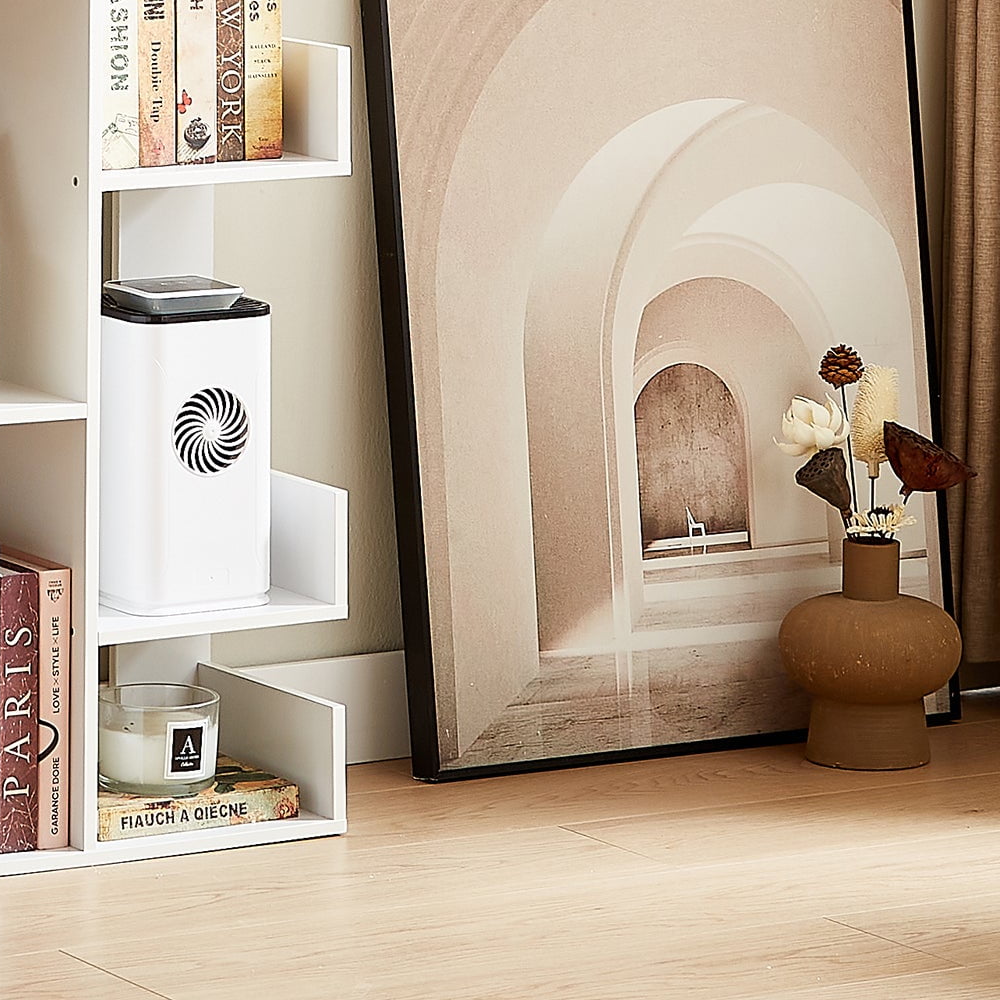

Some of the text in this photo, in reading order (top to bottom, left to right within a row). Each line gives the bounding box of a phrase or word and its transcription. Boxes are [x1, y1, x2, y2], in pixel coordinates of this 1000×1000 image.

[150, 96, 163, 123] Tap
[220, 50, 243, 145] YORK
[51, 616, 60, 636] LIFE
[51, 646, 60, 676] STYLE
[3, 626, 32, 800] PARIS
[52, 687, 60, 714] LOVE
[180, 735, 196, 754] A
[50, 757, 60, 835] GARANCE DORE
[120, 811, 175, 830] FIAUCH
[180, 809, 190, 823] A
